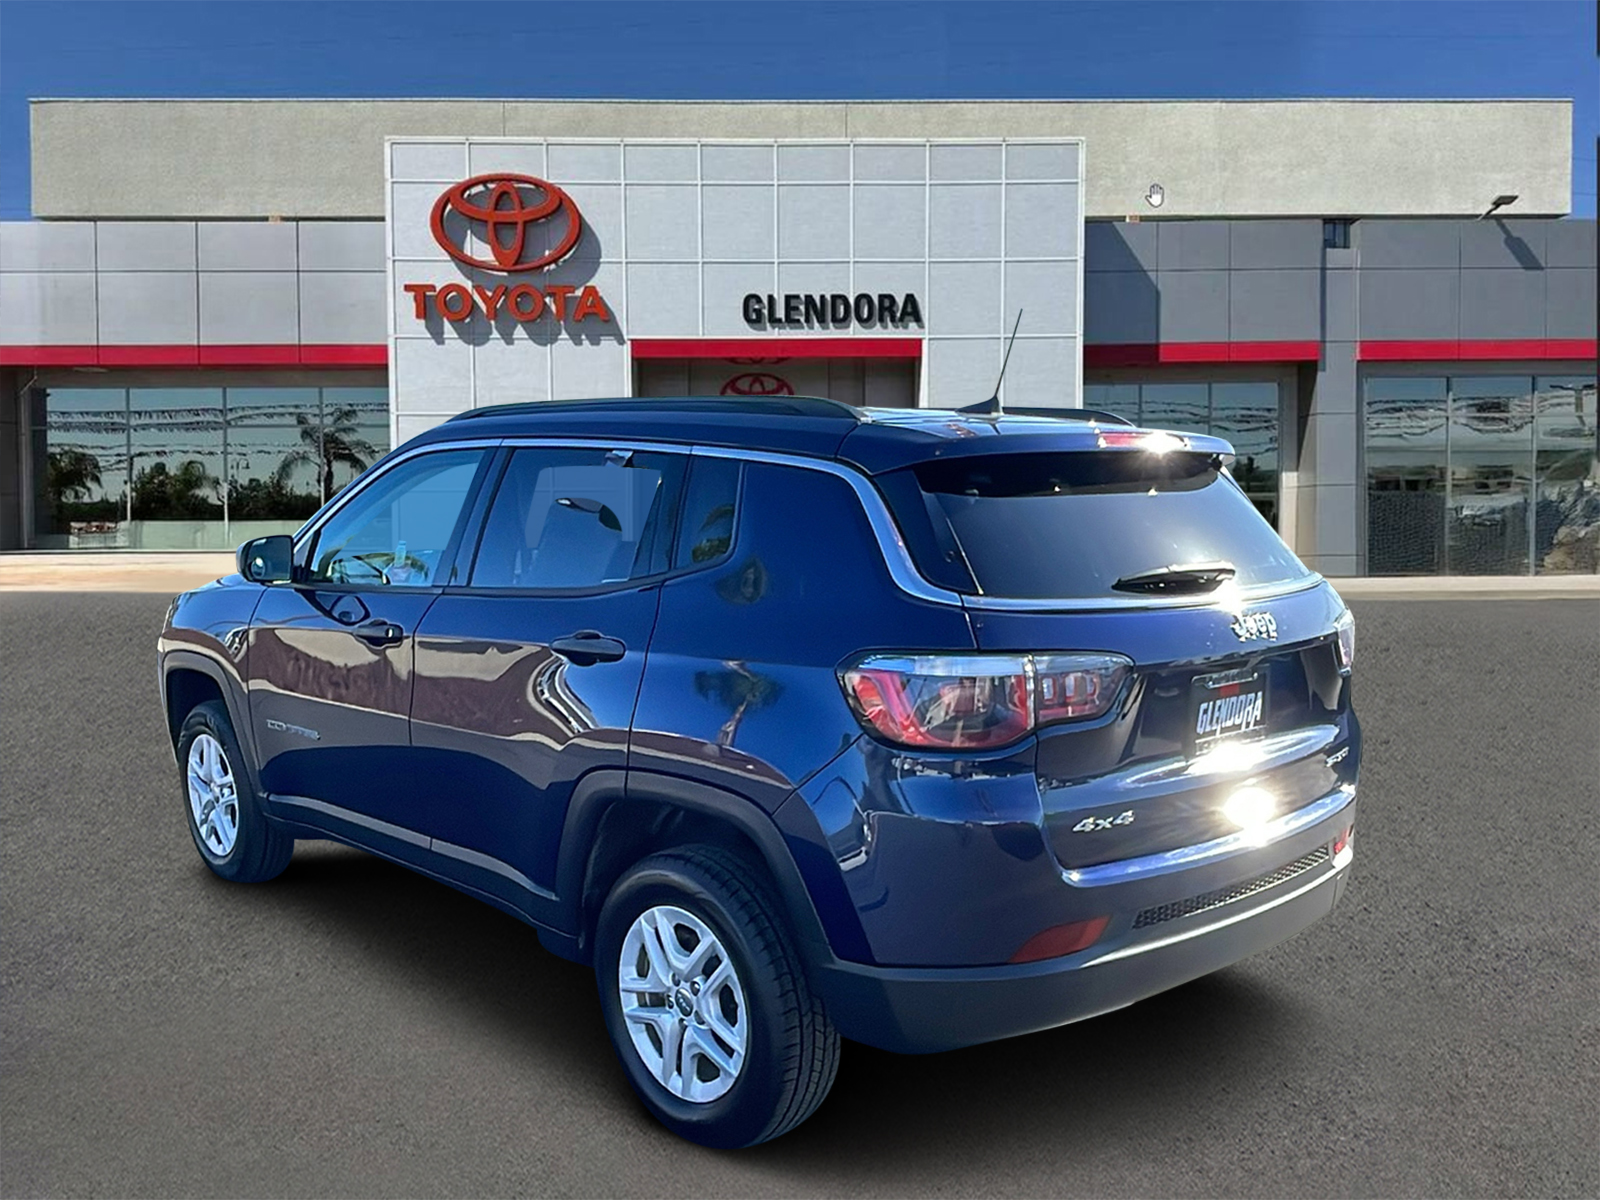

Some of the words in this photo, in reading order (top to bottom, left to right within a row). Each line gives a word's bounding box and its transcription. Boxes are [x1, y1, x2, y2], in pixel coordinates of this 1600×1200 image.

[404, 283, 610, 322] TOYOTA
[743, 293, 923, 325] GLENDORA
[1230, 611, 1278, 642] Jeep
[1196, 691, 1263, 735] GLENDORA
